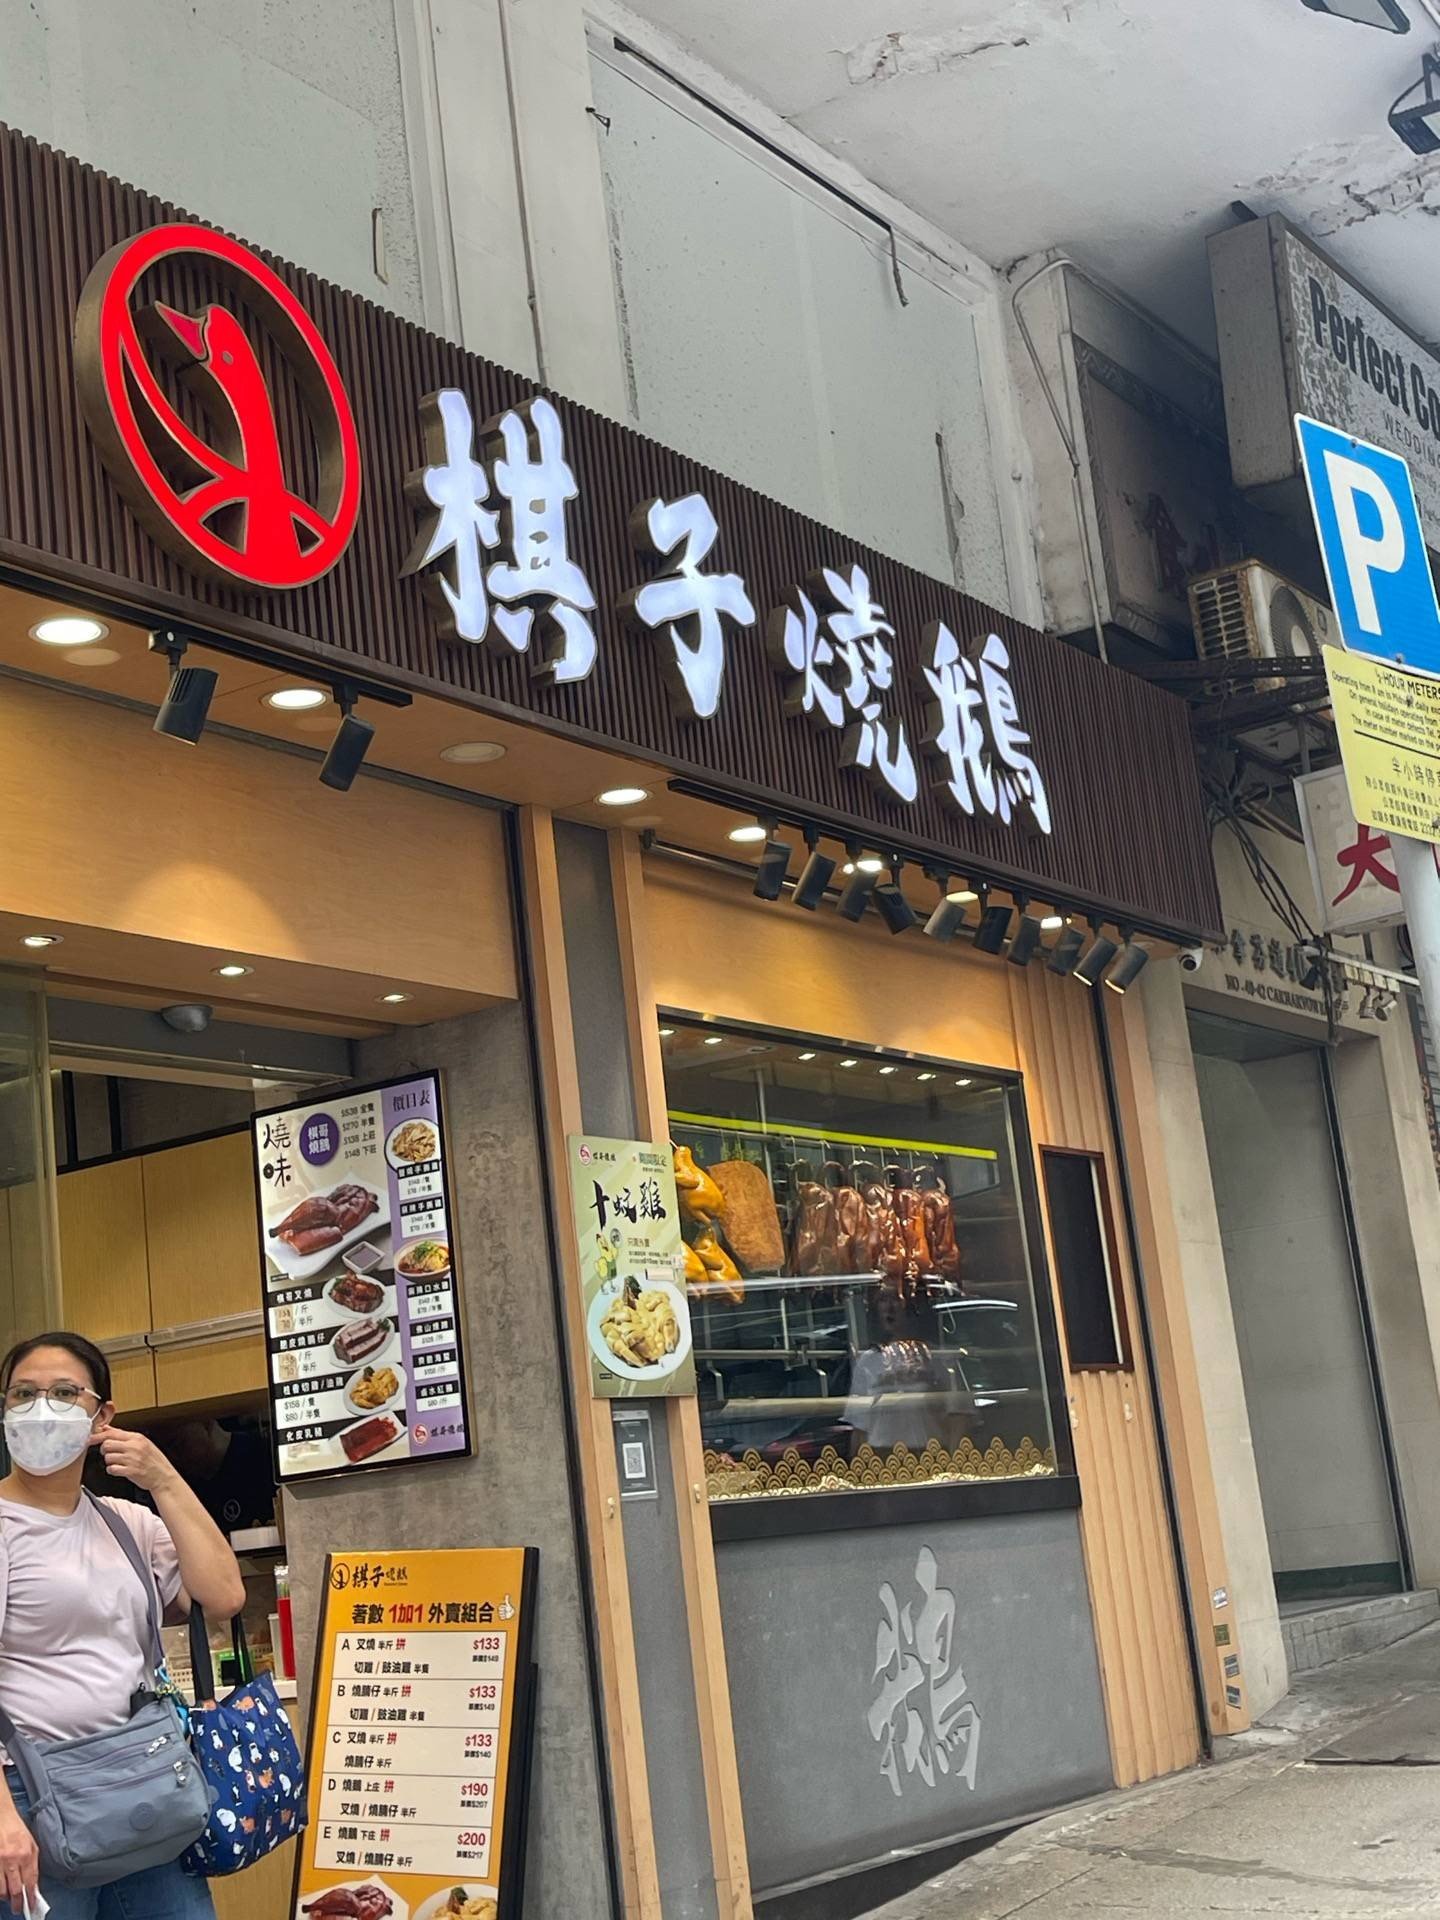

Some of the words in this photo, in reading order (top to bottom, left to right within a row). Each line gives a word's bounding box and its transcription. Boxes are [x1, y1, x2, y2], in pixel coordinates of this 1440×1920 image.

[1309, 276, 1411, 417] Perfect
[1323, 450, 1405, 637] P
[393, 1088, 431, 1112] 價目表
[262, 1115, 292, 1188] 燒味
[589, 1176, 667, 1232] 十蚊雞
[352, 1603, 385, 1624] 著數
[389, 1603, 424, 1624] 1加1
[428, 1602, 495, 1624] 外賣組合
[341, 1638, 350, 1651] A
[356, 1638, 376, 1651] 叉燒
[378, 1640, 394, 1650] 半斤
[473, 1638, 500, 1650] $133
[337, 1685, 346, 1697] B
[383, 1687, 399, 1697] 半斤
[469, 1686, 496, 1698] $133
[333, 1731, 341, 1744] C
[347, 1731, 367, 1745] 叉燒
[369, 1734, 385, 1744] 半斤
[465, 1734, 492, 1747] $133
[376, 1758, 392, 1768] 半斤
[328, 1778, 337, 1791] D
[343, 1779, 362, 1792] 燒鵝
[461, 1783, 489, 1796] $190
[340, 1802, 360, 1816] 叉燒
[400, 1807, 417, 1818] 半斤
[323, 1826, 332, 1839] E
[338, 1827, 358, 1840] 燒鵝
[457, 1832, 486, 1846] $200
[336, 1851, 355, 1864] 叉燒
[396, 1856, 413, 1867] 半斤
